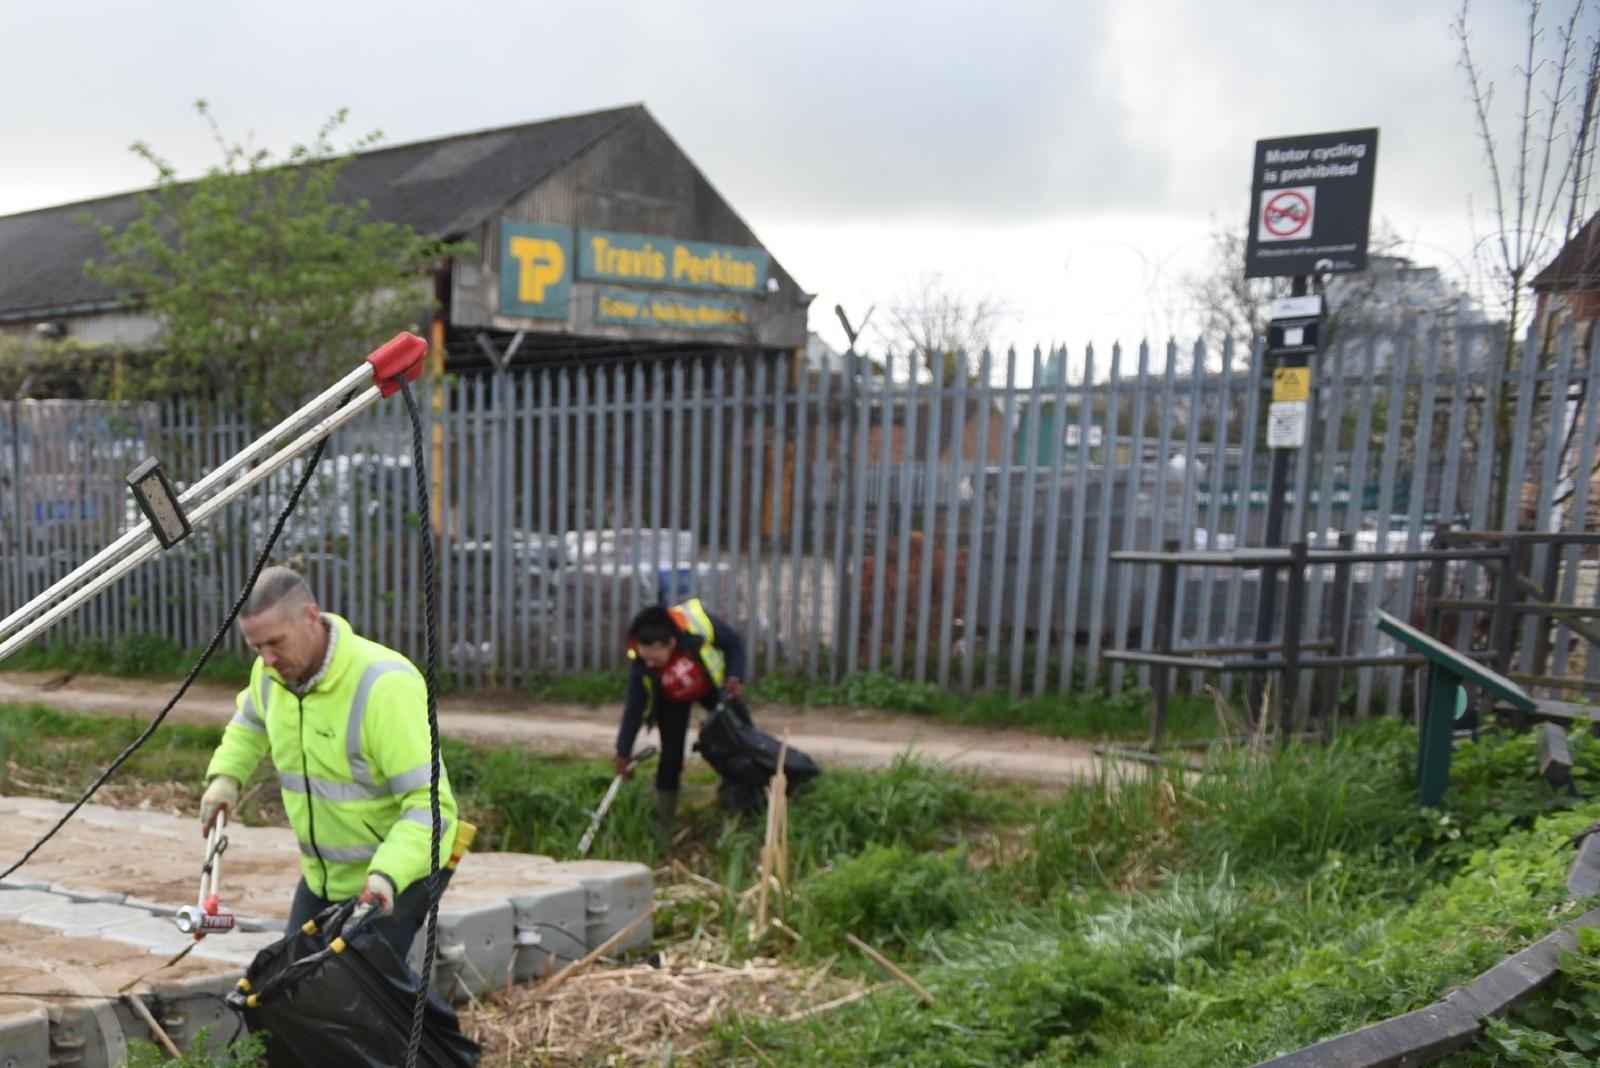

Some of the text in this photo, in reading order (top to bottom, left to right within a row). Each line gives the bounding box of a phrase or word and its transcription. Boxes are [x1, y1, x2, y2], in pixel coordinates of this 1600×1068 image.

[1263, 160, 1359, 184] is prohibited
[1264, 142, 1367, 165] Motor cycling
[510, 236, 566, 305] TP
[591, 236, 757, 291] Travis Perkins
